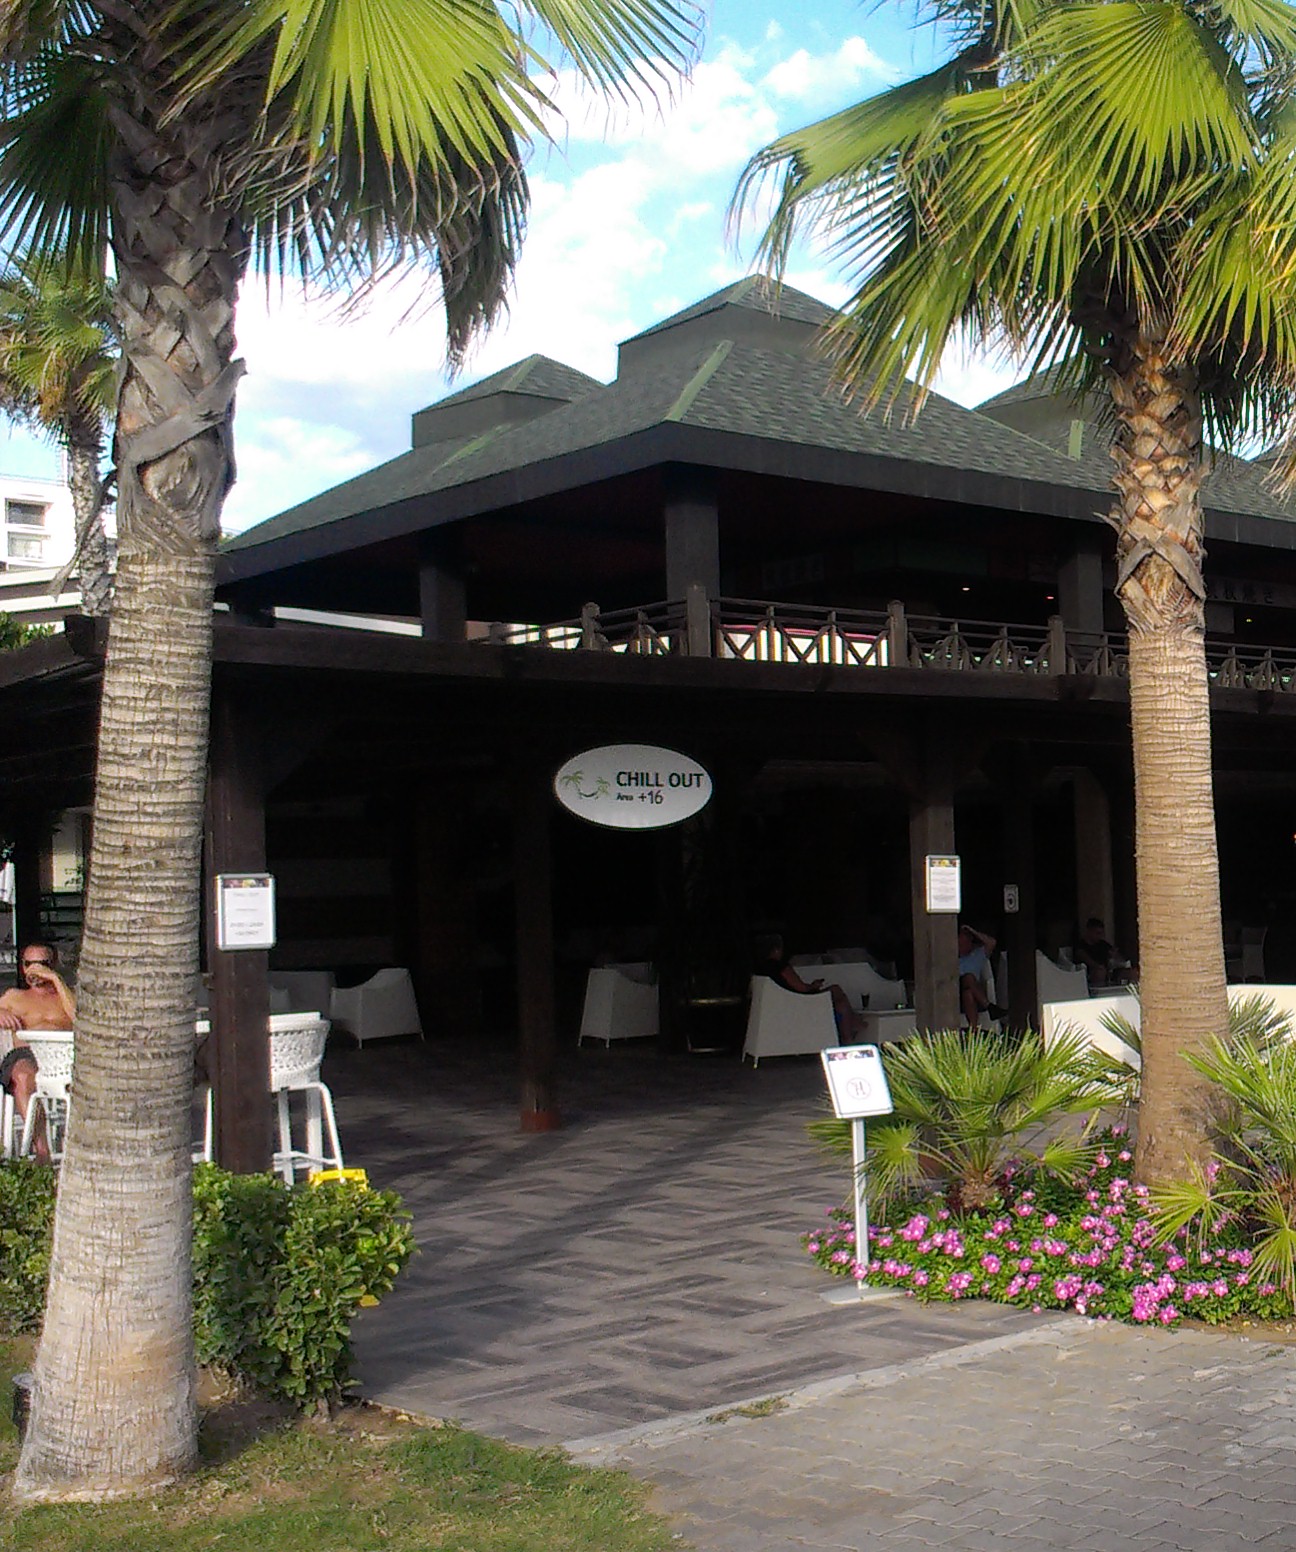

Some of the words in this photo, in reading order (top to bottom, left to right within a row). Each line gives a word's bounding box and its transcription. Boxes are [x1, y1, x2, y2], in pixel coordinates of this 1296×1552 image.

[616, 771, 665, 787] CHILL
[668, 772, 704, 788] OUT
[638, 790, 664, 805] +16
